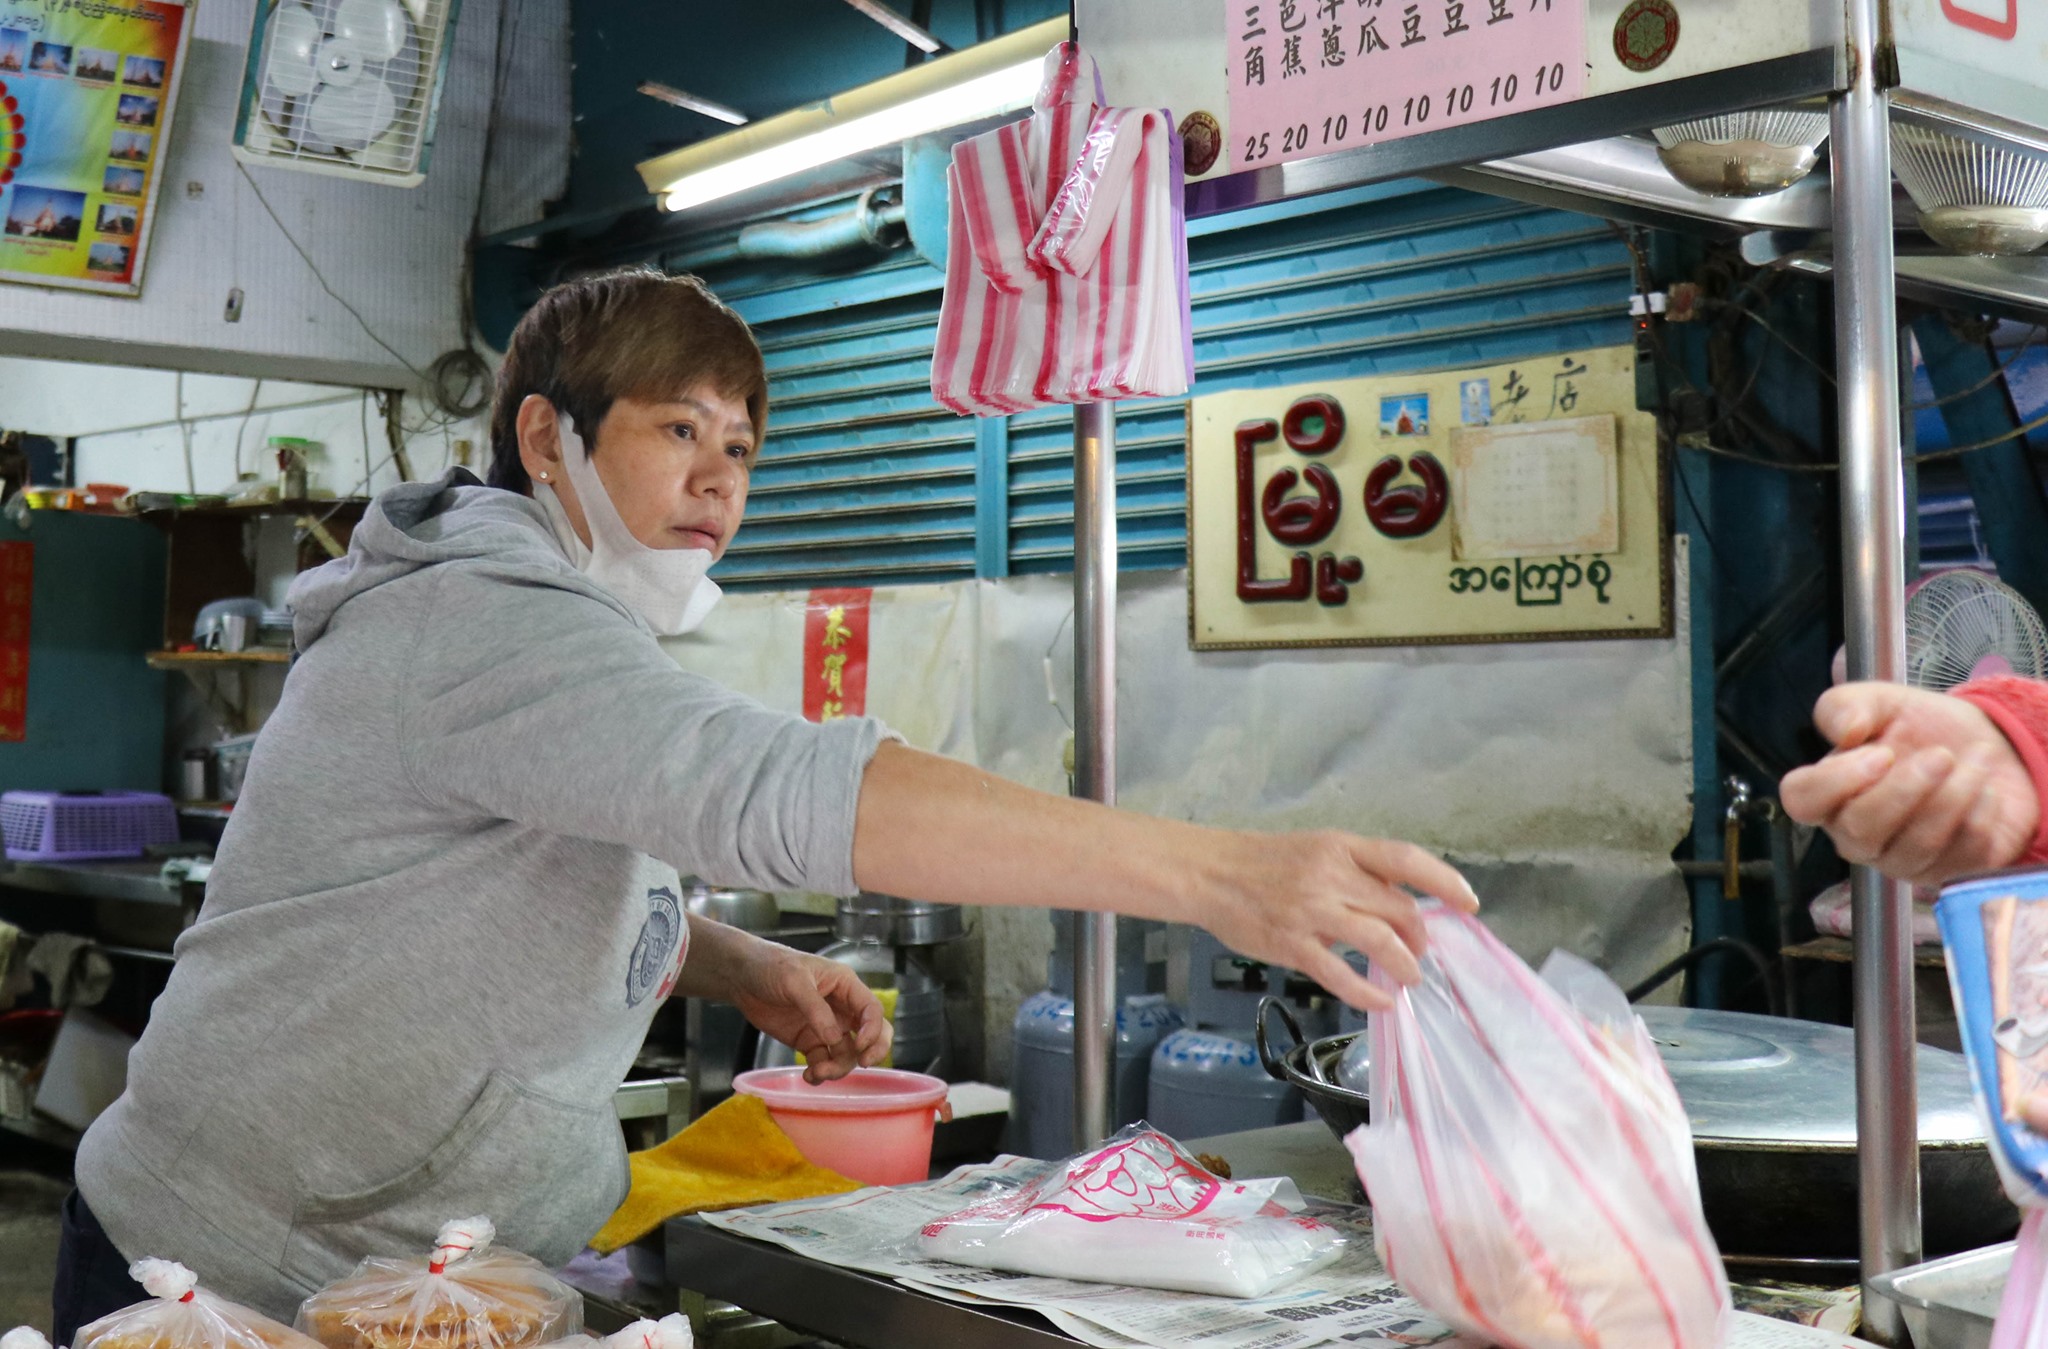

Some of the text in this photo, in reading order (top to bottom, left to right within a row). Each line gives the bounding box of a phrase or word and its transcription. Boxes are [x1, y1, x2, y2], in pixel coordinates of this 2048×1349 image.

[1242, 6, 1266, 86] 三角
[1280, 0, 1306, 79] 芭蕉
[1357, 0, 1390, 56] 瓜
[1245, 132, 1270, 162] 25
[1282, 123, 1308, 153] 20
[1322, 114, 1348, 145] 10
[1362, 104, 1389, 136] 10
[1403, 94, 1430, 126] 10
[1446, 84, 1474, 117] 10
[1490, 73, 1518, 106] 10
[1535, 62, 1564, 96] 10
